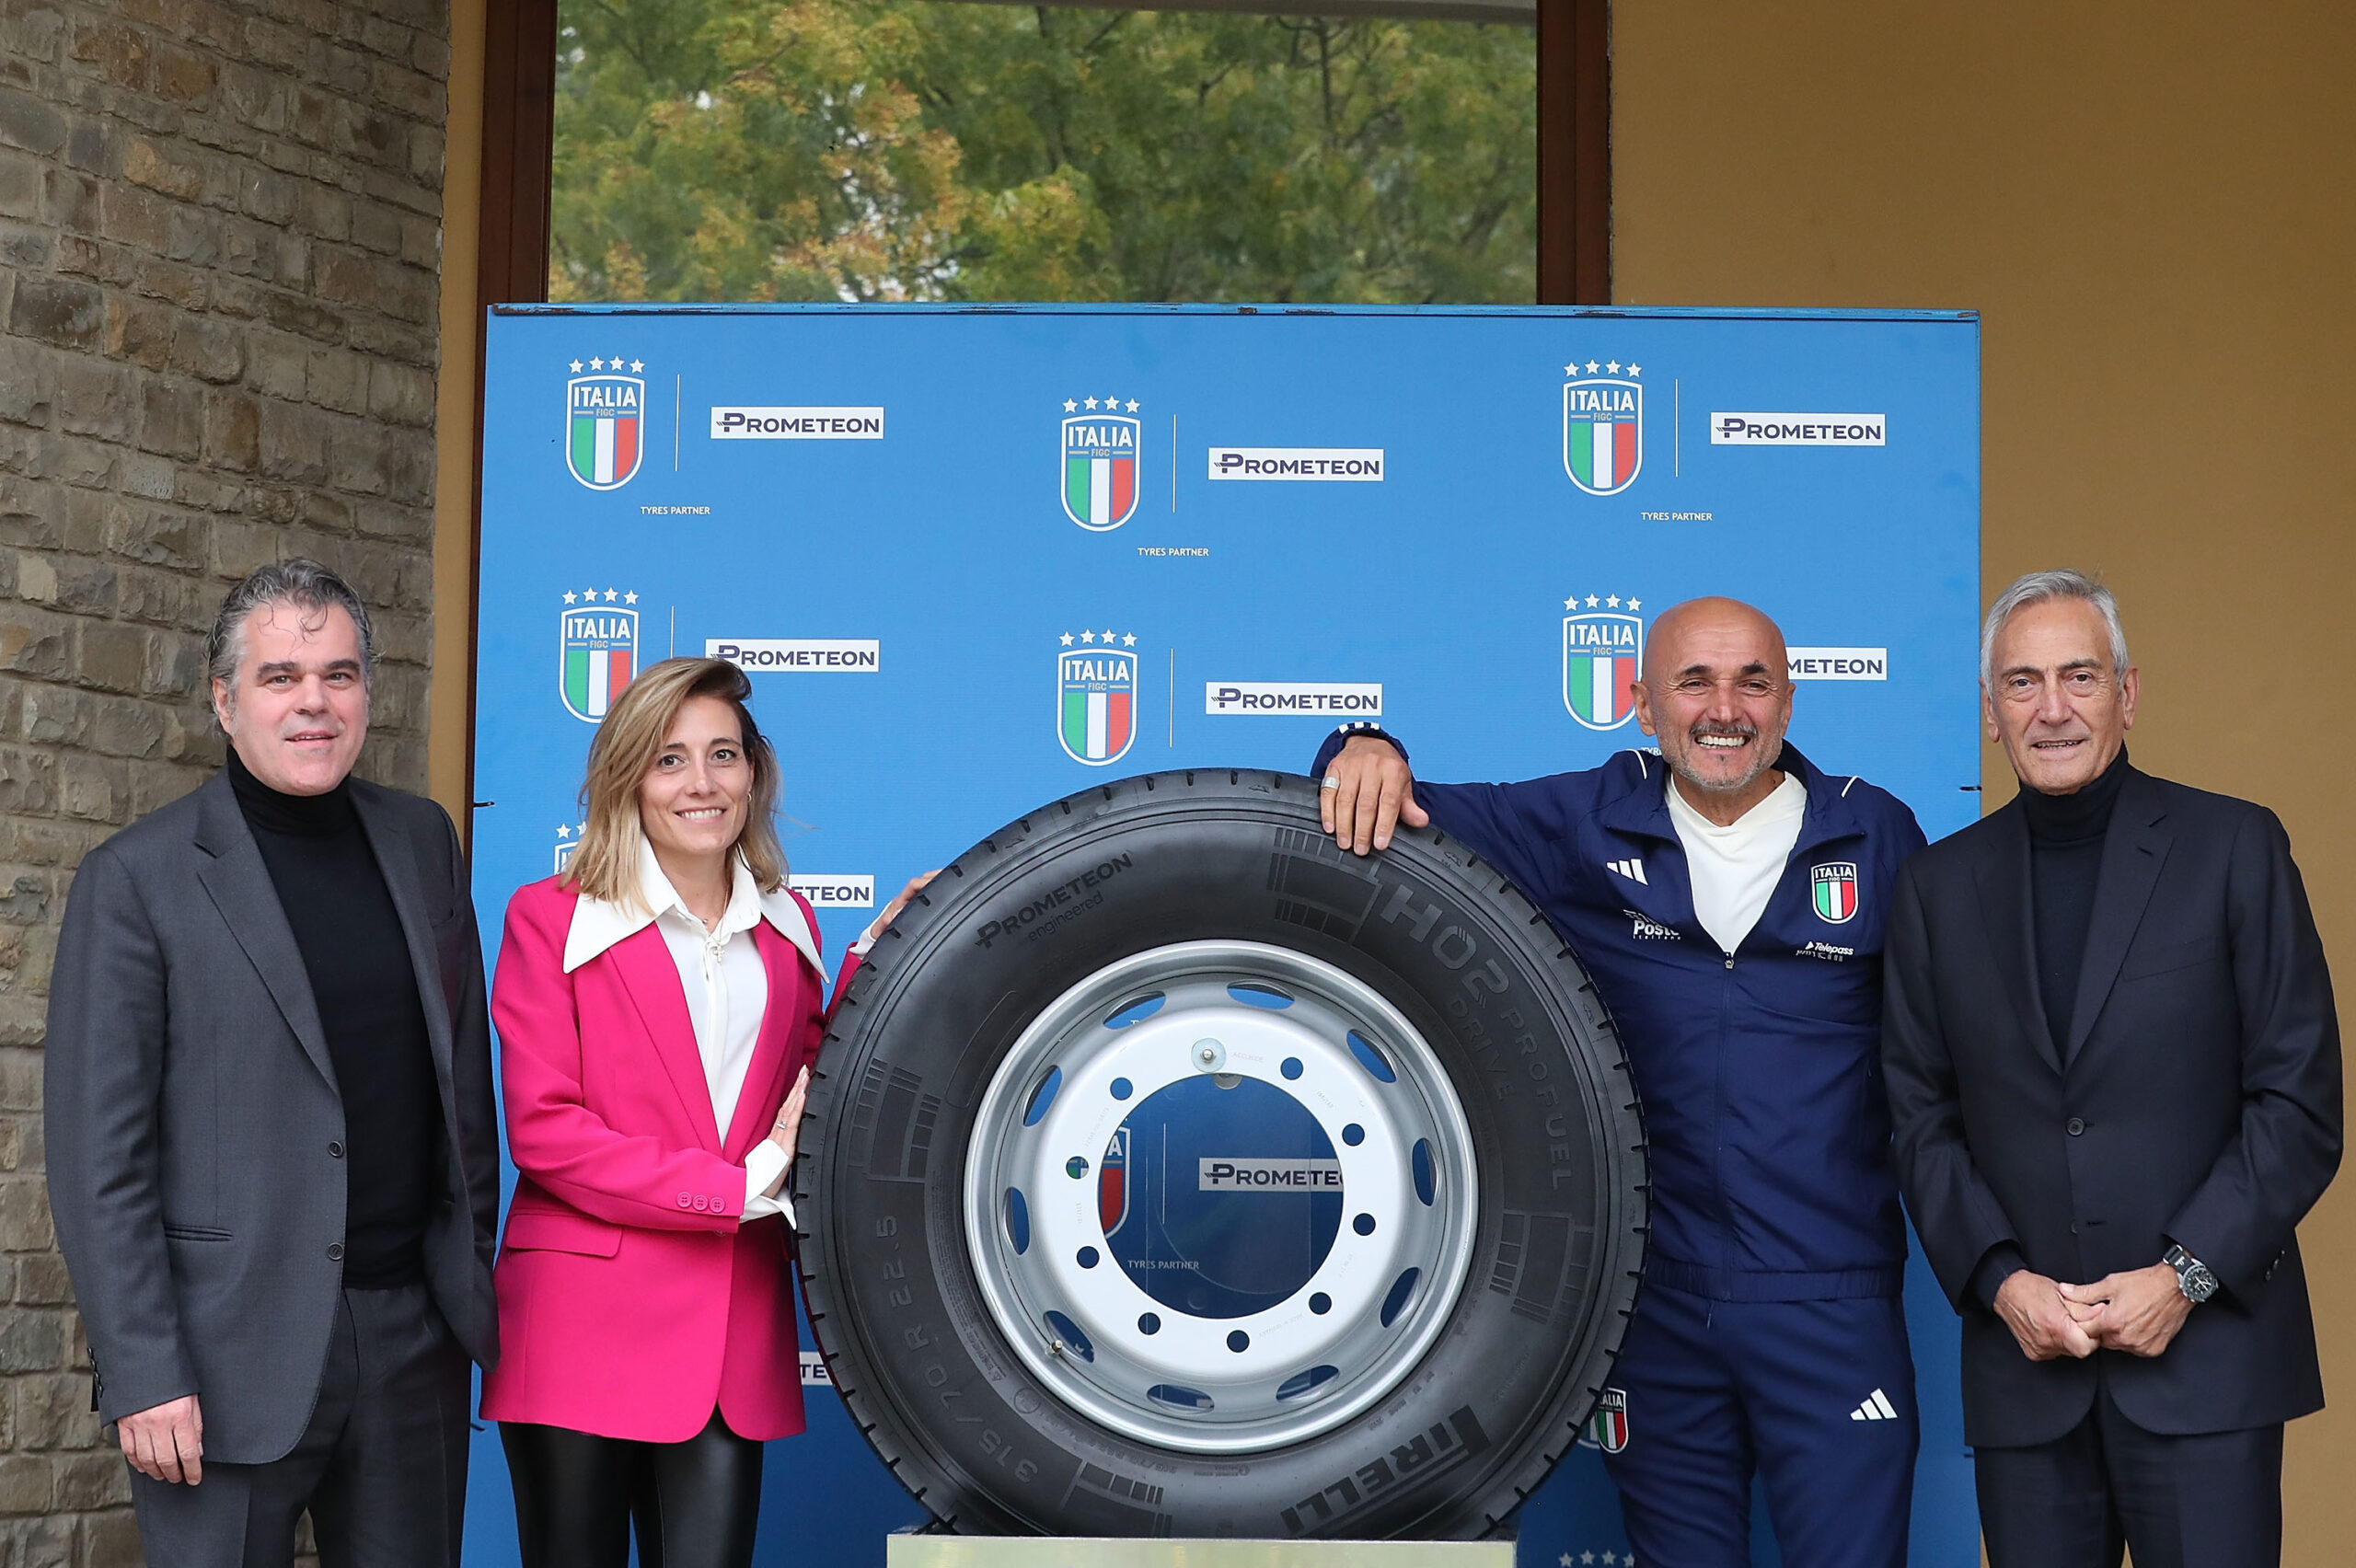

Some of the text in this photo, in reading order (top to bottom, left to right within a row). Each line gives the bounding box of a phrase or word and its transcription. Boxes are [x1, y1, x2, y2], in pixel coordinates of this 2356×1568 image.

[573, 386, 637, 408] ITALIA
[1570, 390, 1635, 411] ITALIA
[595, 409, 615, 417] FIGC
[717, 412, 880, 433] PROMETEON
[1593, 412, 1612, 421] FIGC
[1068, 426, 1133, 448] ITALIA
[1717, 418, 1882, 440] PROMETEON
[1091, 448, 1110, 457] FIGC
[1215, 453, 1380, 476] PROMETEON
[641, 506, 710, 515] TYRES PARTNER
[1641, 512, 1713, 522] TYRES PARTNER
[1138, 547, 1209, 558] TYRES PARTNER
[567, 617, 631, 640] ITALIA
[1569, 625, 1635, 646] ITALIA
[589, 640, 608, 649] FIGC
[711, 644, 875, 666] PROMETEON
[1593, 647, 1612, 656] FIGC
[1065, 660, 1130, 682] ITALIA
[1788, 659, 1882, 674] METEON
[1087, 682, 1107, 691] FIGC
[1211, 687, 1378, 710] PROMETEON
[1815, 867, 1854, 879] ITALIA
[975, 852, 1133, 949] PROMETEON
[1028, 891, 1104, 943] engineered
[1815, 942, 1854, 955] Telepass
[1450, 998, 1517, 1101] DRIVE
[1500, 1012, 1573, 1191] PROFUEL
[1205, 1163, 1343, 1186] PROMETE
[876, 1215, 912, 1309] 22.5
[1127, 1260, 1199, 1270] TYRES PARTNER
[903, 1325, 930, 1351] R
[1602, 1393, 1623, 1407] ALIA
[924, 1365, 1039, 1482] 315/70
[1281, 1405, 1492, 1536] PIRELLI
